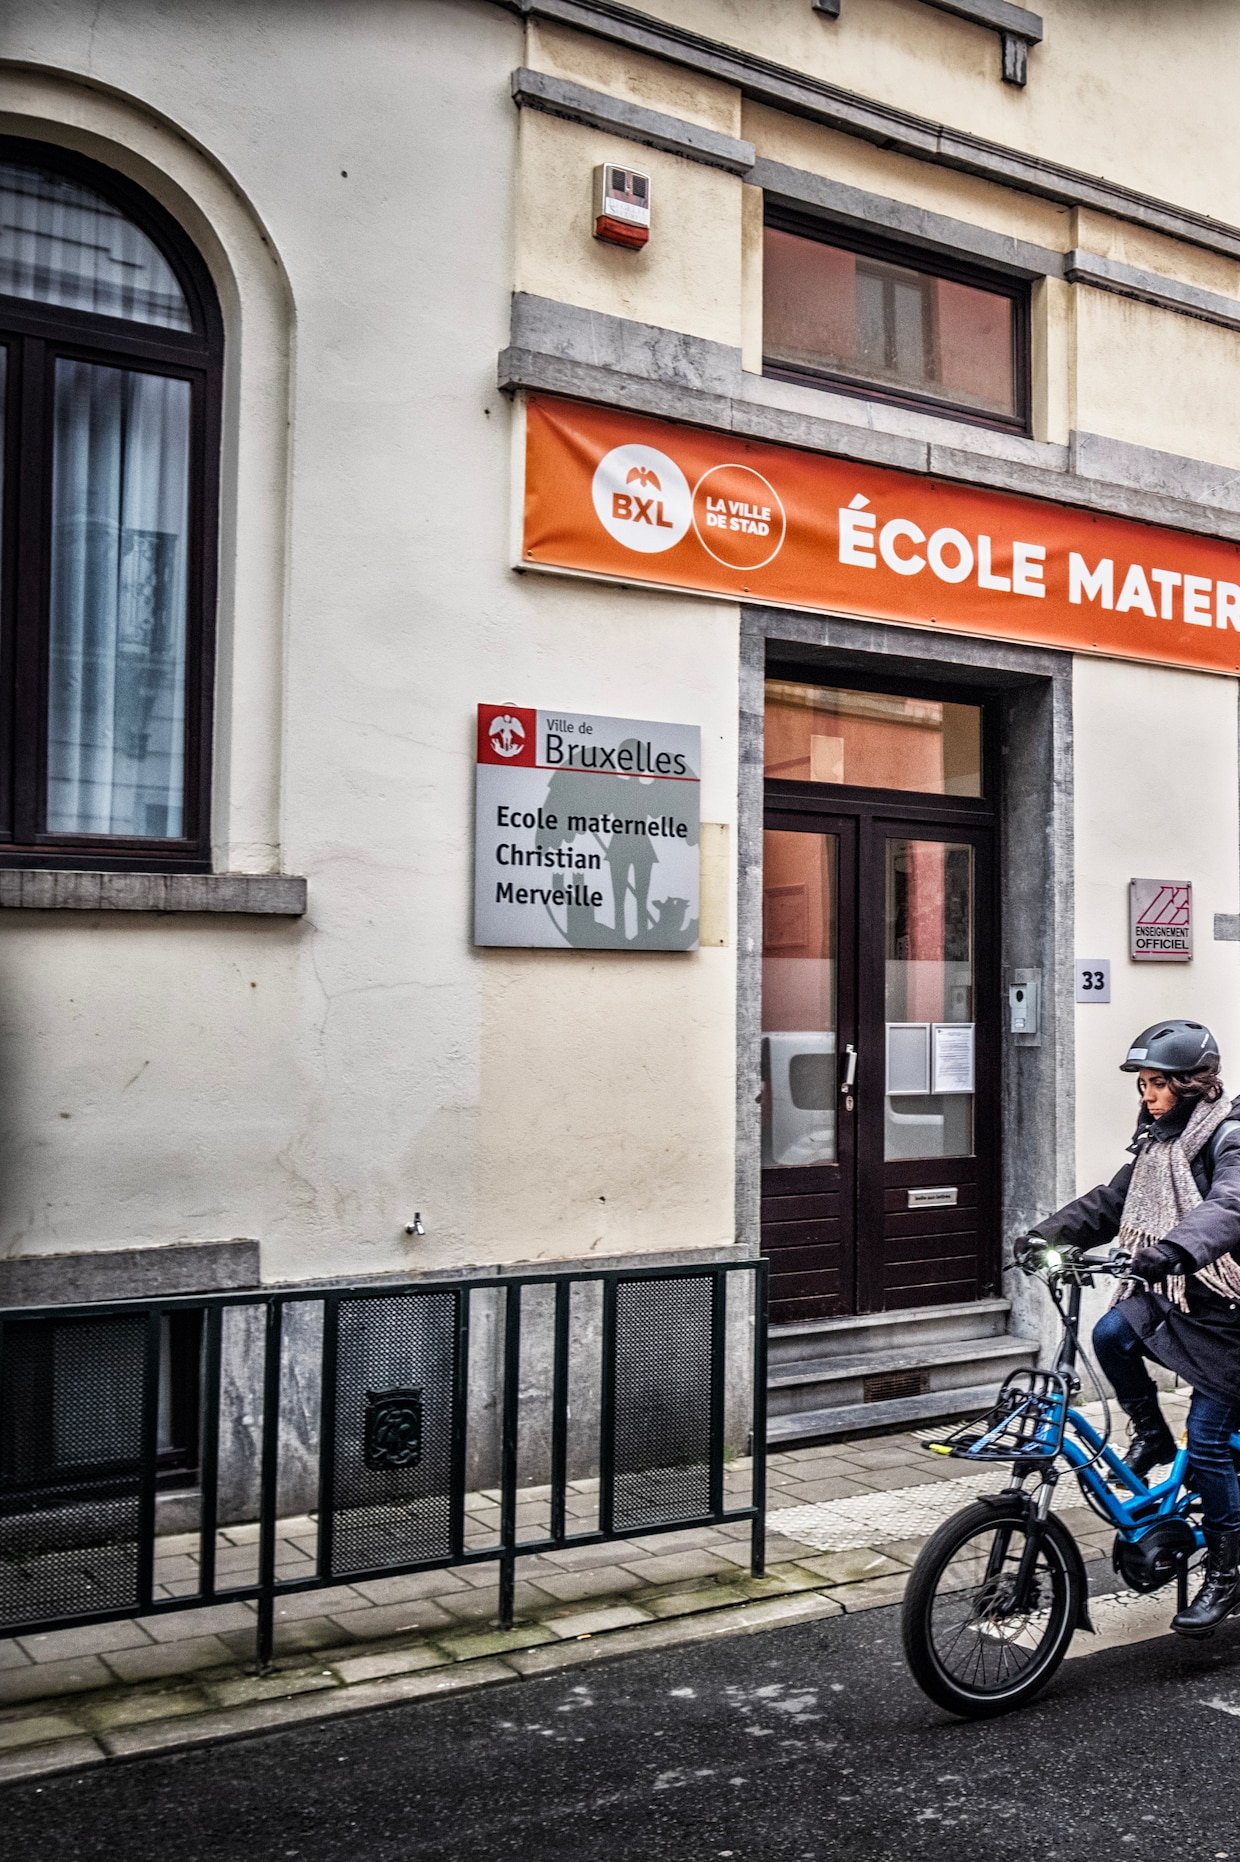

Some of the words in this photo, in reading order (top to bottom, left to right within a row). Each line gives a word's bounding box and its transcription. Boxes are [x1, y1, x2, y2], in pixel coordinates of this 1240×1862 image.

[612, 492, 673, 529] BXL
[706, 496, 727, 513] LA
[729, 500, 771, 521] VILLE
[706, 513, 727, 529] DE
[729, 517, 769, 536] STAD
[838, 492, 1048, 599] ÉCOLE
[546, 718, 575, 734] Ville
[578, 721, 594, 735] de
[545, 733, 687, 776] Bruxelles
[496, 805, 559, 831] Ecole
[567, 813, 689, 839] maternelle
[495, 842, 602, 871] Christian
[495, 881, 604, 908] Merveille
[1135, 926, 1190, 938] ENSEIGNEMENT
[1135, 938, 1190, 950] OFFICIEL
[1081, 970, 1105, 991] 33
